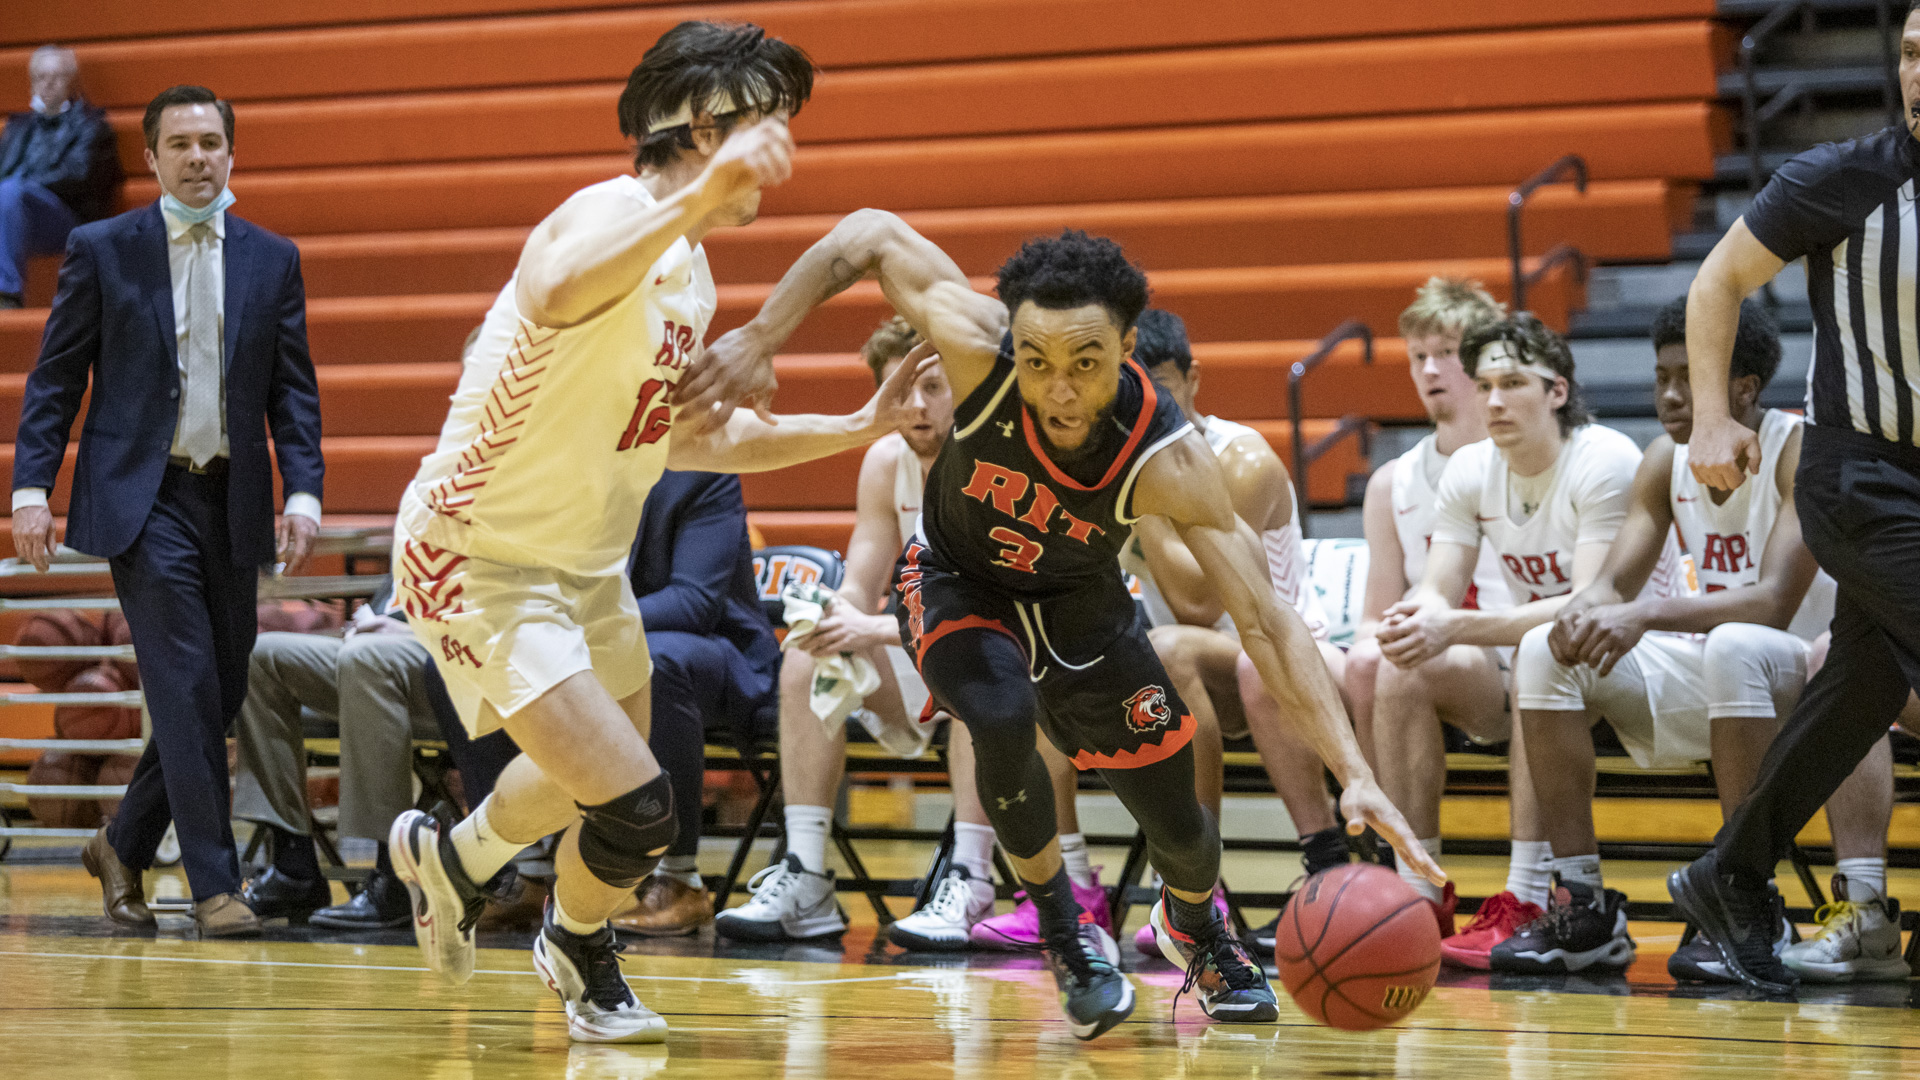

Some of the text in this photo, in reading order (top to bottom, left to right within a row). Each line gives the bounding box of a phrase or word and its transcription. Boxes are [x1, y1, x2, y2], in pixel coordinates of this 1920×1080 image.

[961, 458, 1106, 545] RIT
[989, 526, 1044, 574] 3
[1501, 550, 1570, 586] RPI
[1701, 530, 1755, 573] RPI
[752, 554, 824, 601] IT
[441, 634, 483, 669] RPI
